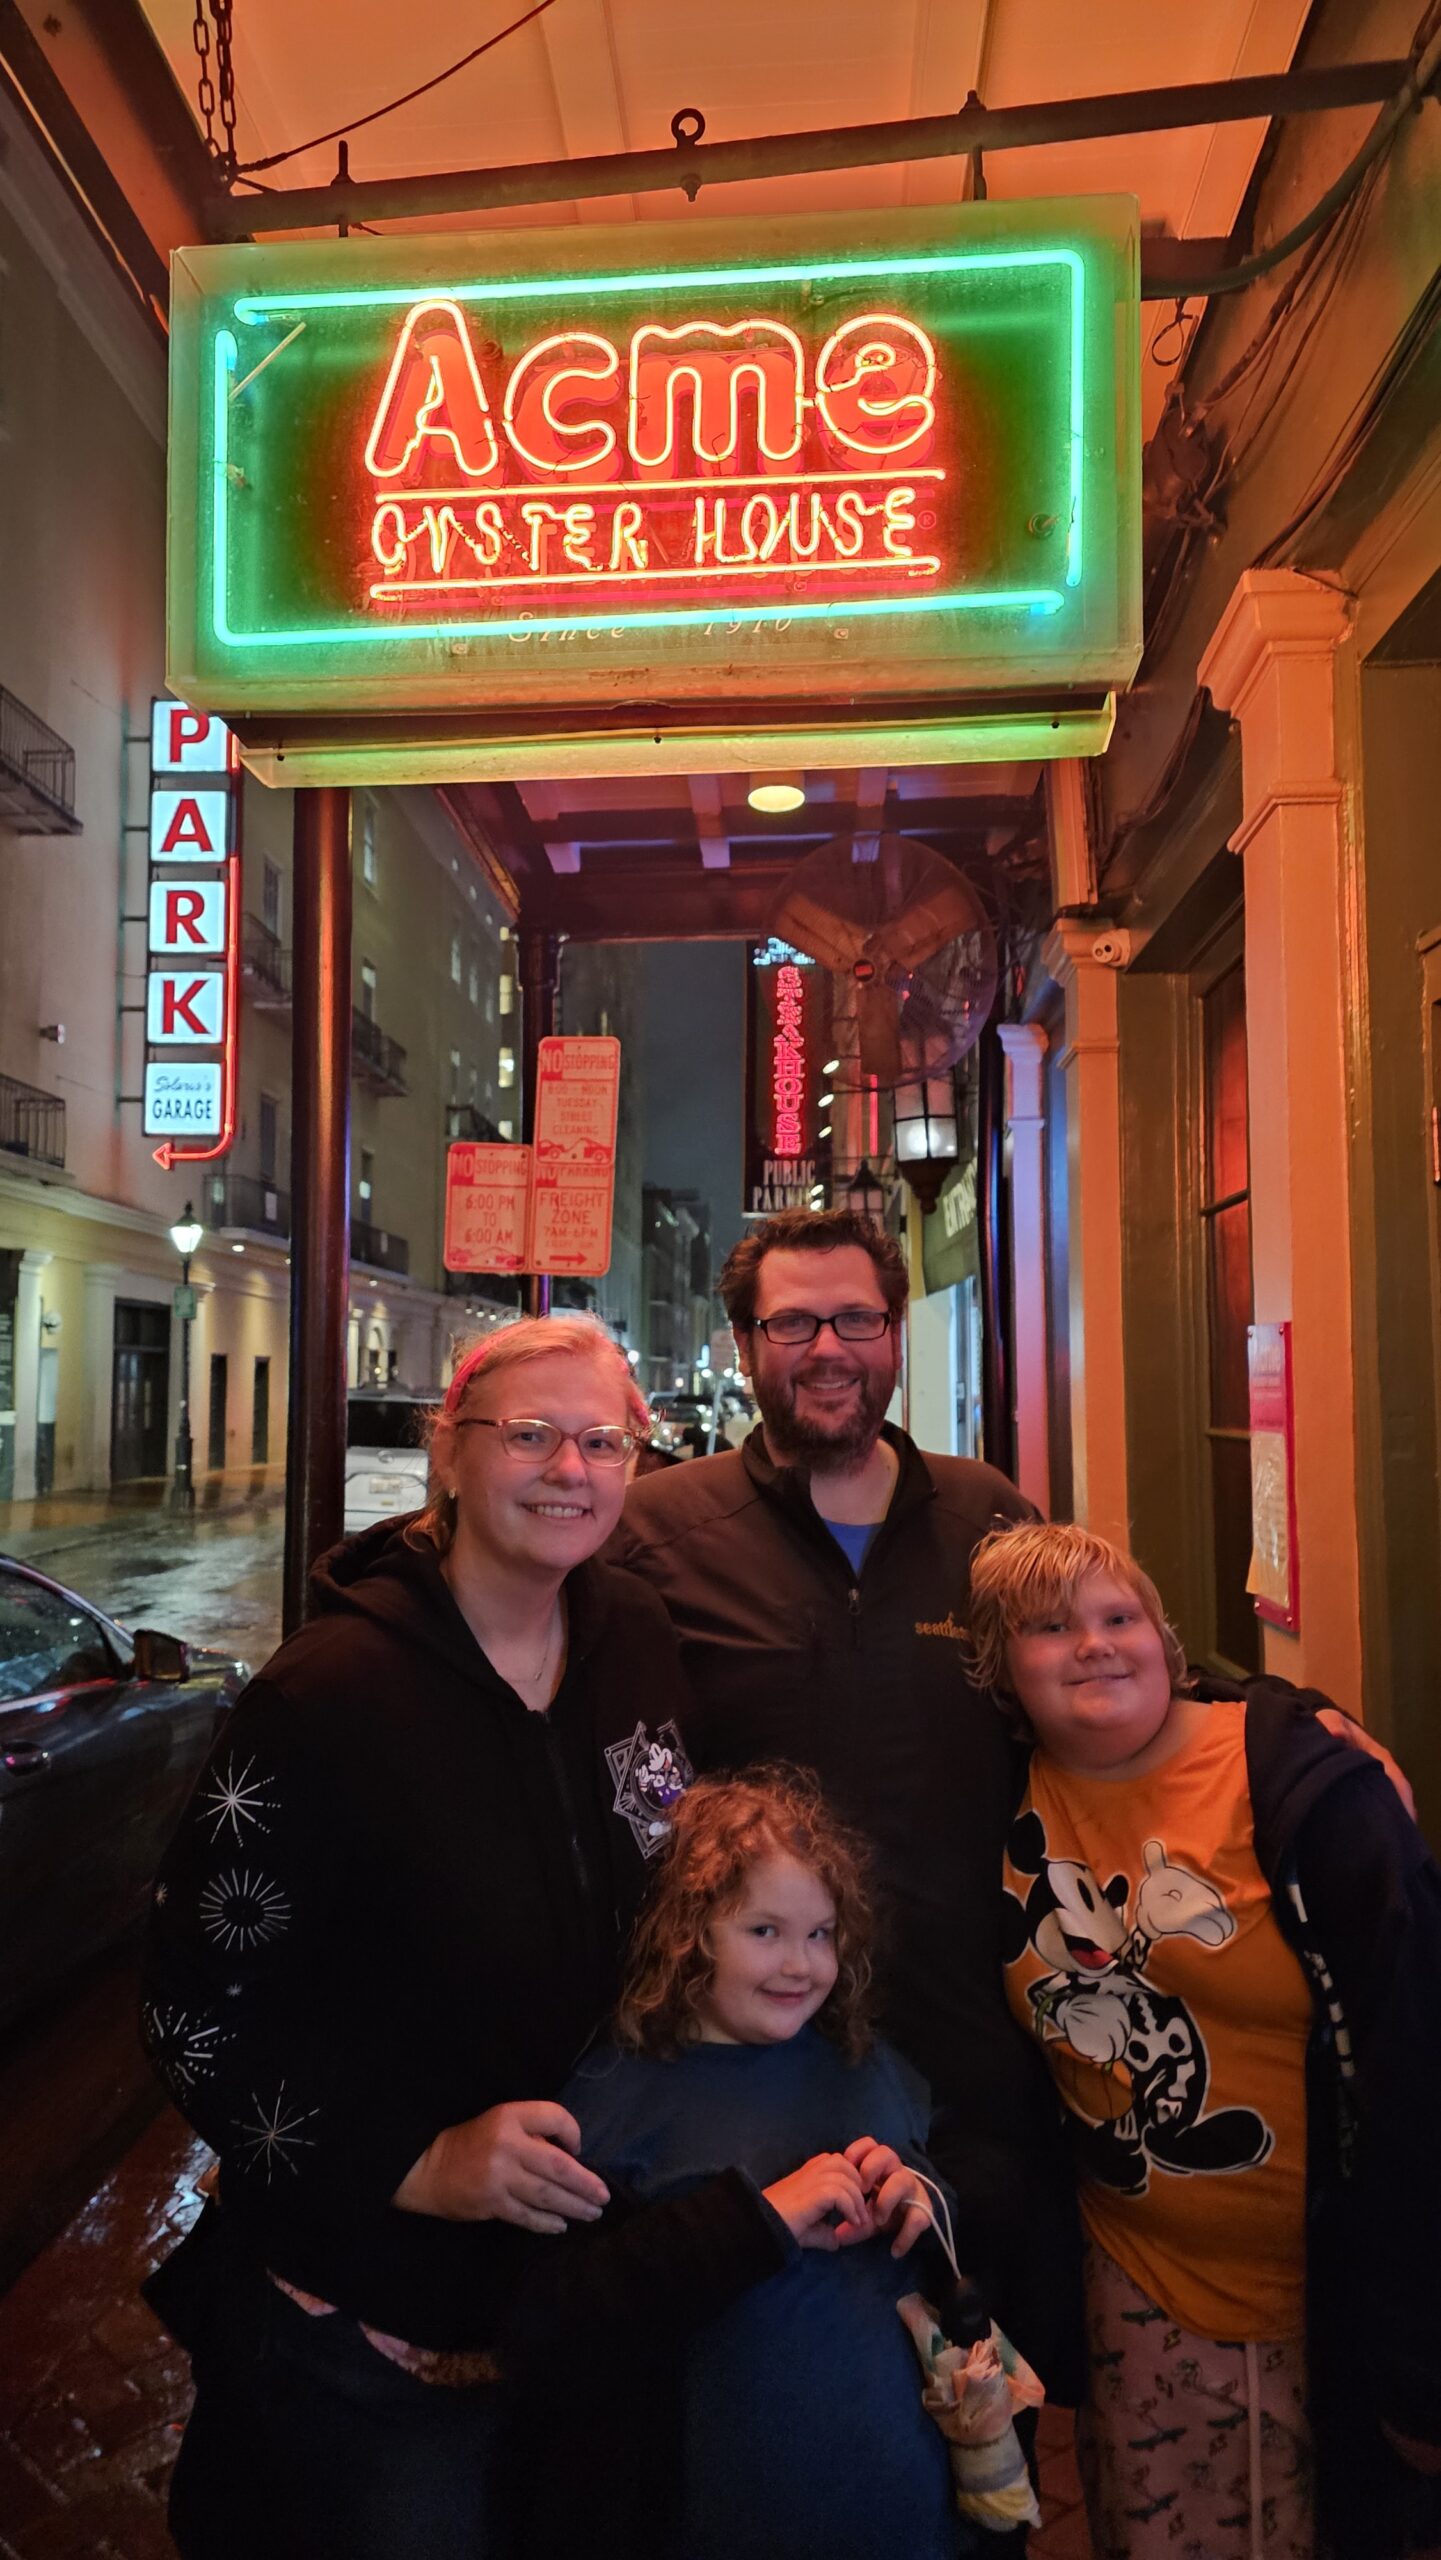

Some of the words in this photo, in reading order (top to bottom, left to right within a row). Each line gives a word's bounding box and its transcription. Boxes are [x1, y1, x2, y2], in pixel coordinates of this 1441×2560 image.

[364, 298, 938, 480] Acme
[370, 500, 649, 575] OYSTER
[692, 487, 919, 562] HOUSE
[158, 708, 215, 1036] PARK
[541, 1050, 563, 1072] NO
[564, 1055, 616, 1069] STOPPING
[773, 965, 805, 1156] STEAKHOUSE
[153, 1099, 212, 1119] GARAGE
[552, 1125, 599, 1136] CLEANING
[452, 1153, 474, 1177] NO
[475, 1159, 528, 1175] STOPPING
[763, 1160, 816, 1186] PUBLIC
[466, 1193, 494, 1210] 6:00
[498, 1194, 516, 1211] PM
[540, 1191, 605, 1208] FREIGHT
[483, 1211, 497, 1227] TO
[551, 1209, 592, 1225] ZONE
[465, 1228, 492, 1244] 6:00
[495, 1229, 514, 1245] AM
